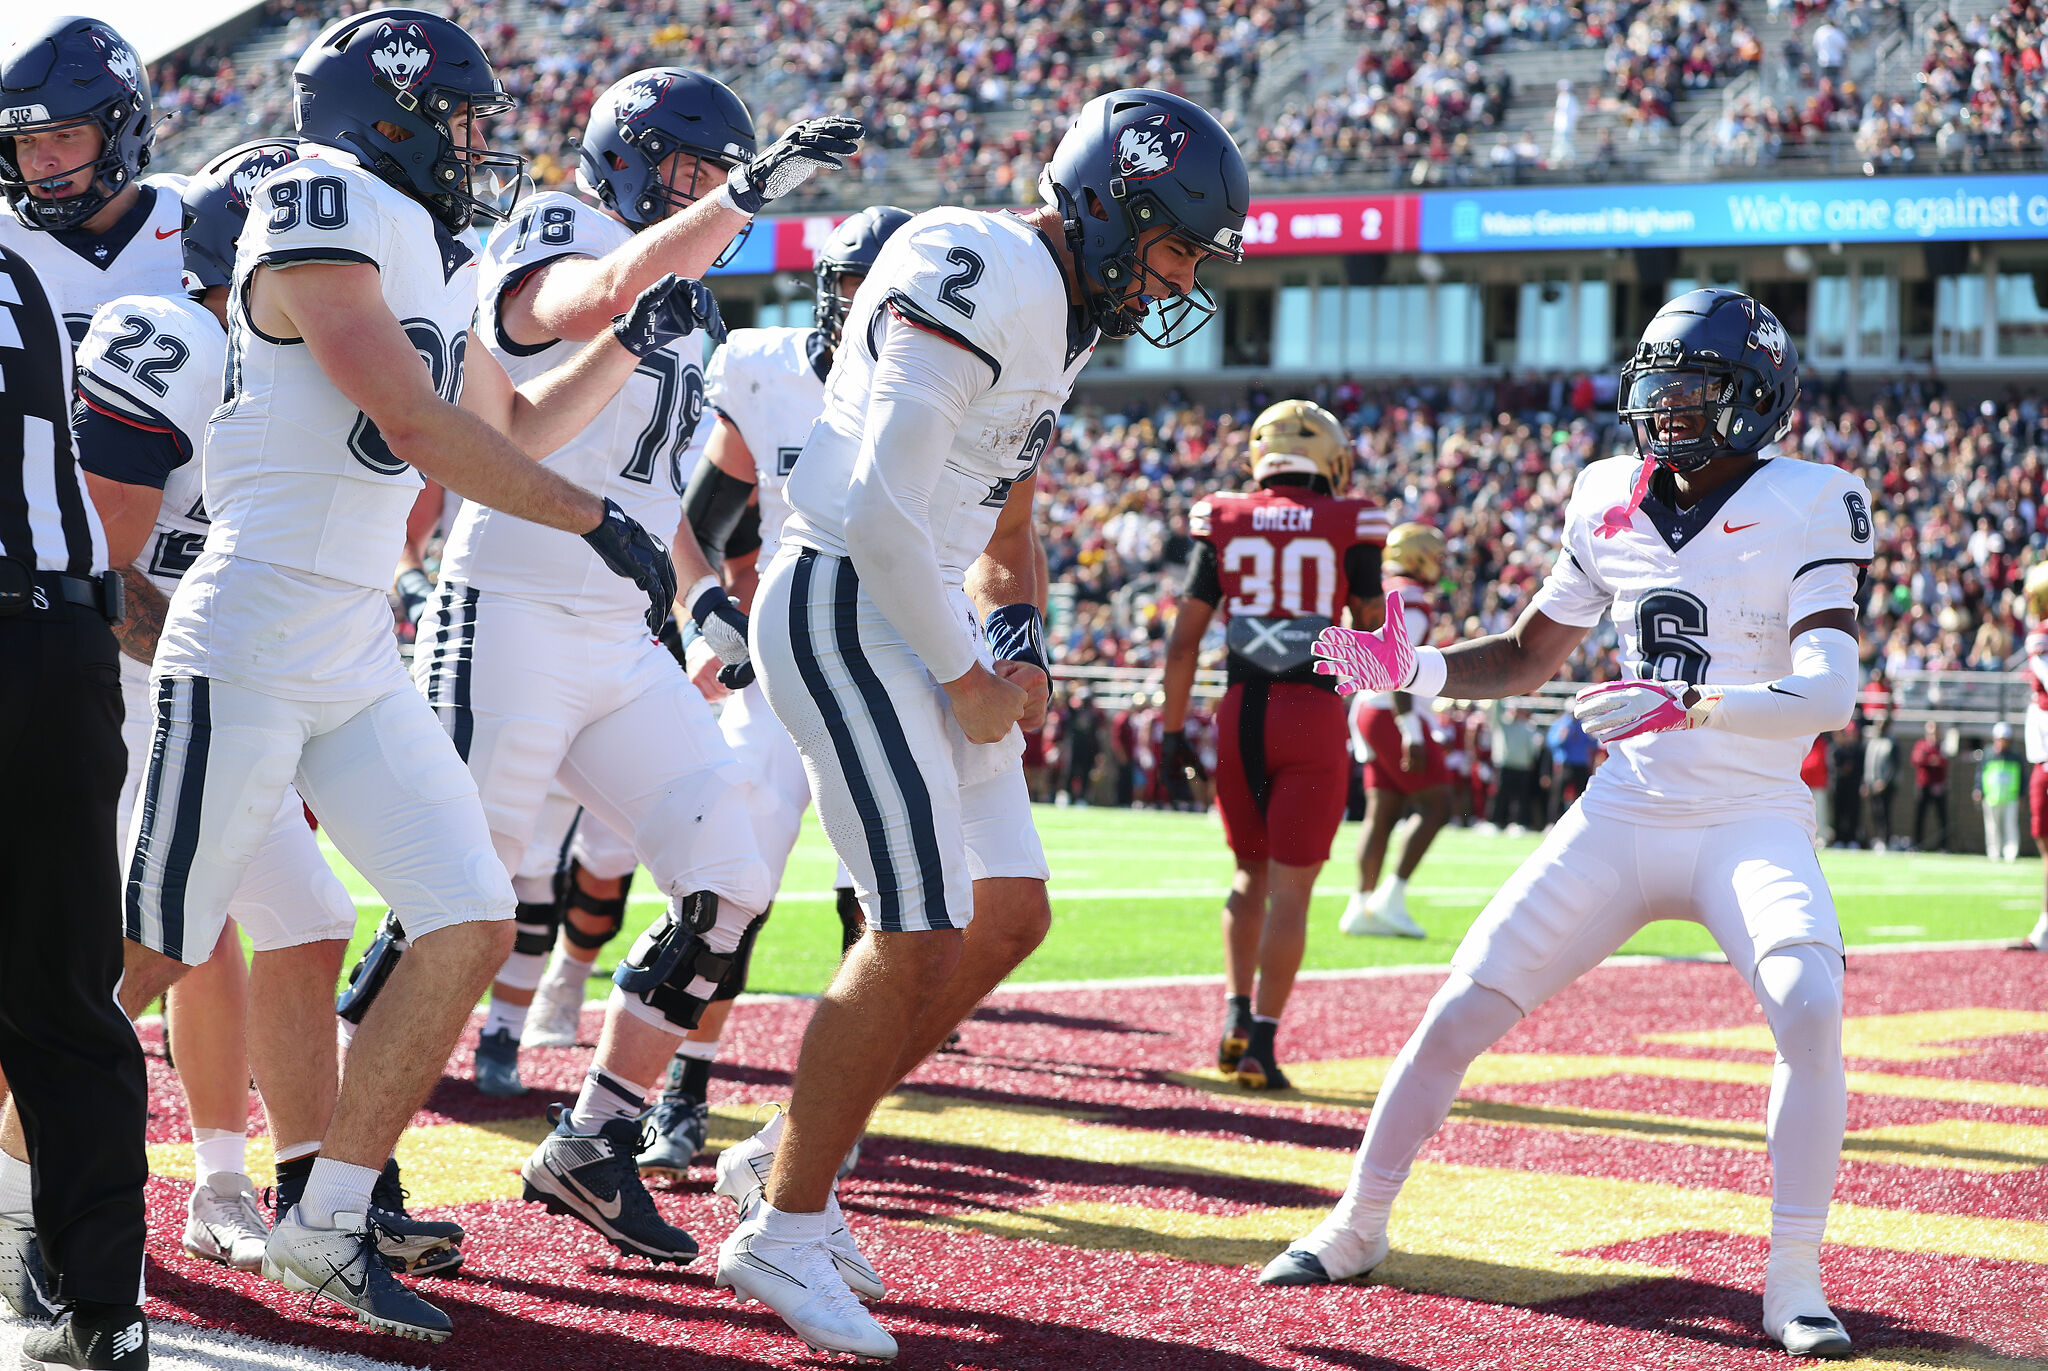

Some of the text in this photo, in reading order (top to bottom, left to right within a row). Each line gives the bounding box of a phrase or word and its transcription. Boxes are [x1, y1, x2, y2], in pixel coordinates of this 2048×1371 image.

[267, 175, 348, 234] 80
[513, 205, 576, 254] 78
[1360, 207, 1382, 240] 2
[1482, 206, 1695, 238] Mass General Brigham
[1728, 193, 1822, 232] We're
[1824, 198, 1891, 231] one
[1894, 187, 2023, 237] against
[937, 246, 986, 320] 2
[101, 313, 191, 399] 22
[1251, 506, 1315, 532] GREEN
[1843, 490, 1871, 544] 6
[1223, 536, 1336, 618] 30
[1634, 587, 1712, 685] 6
